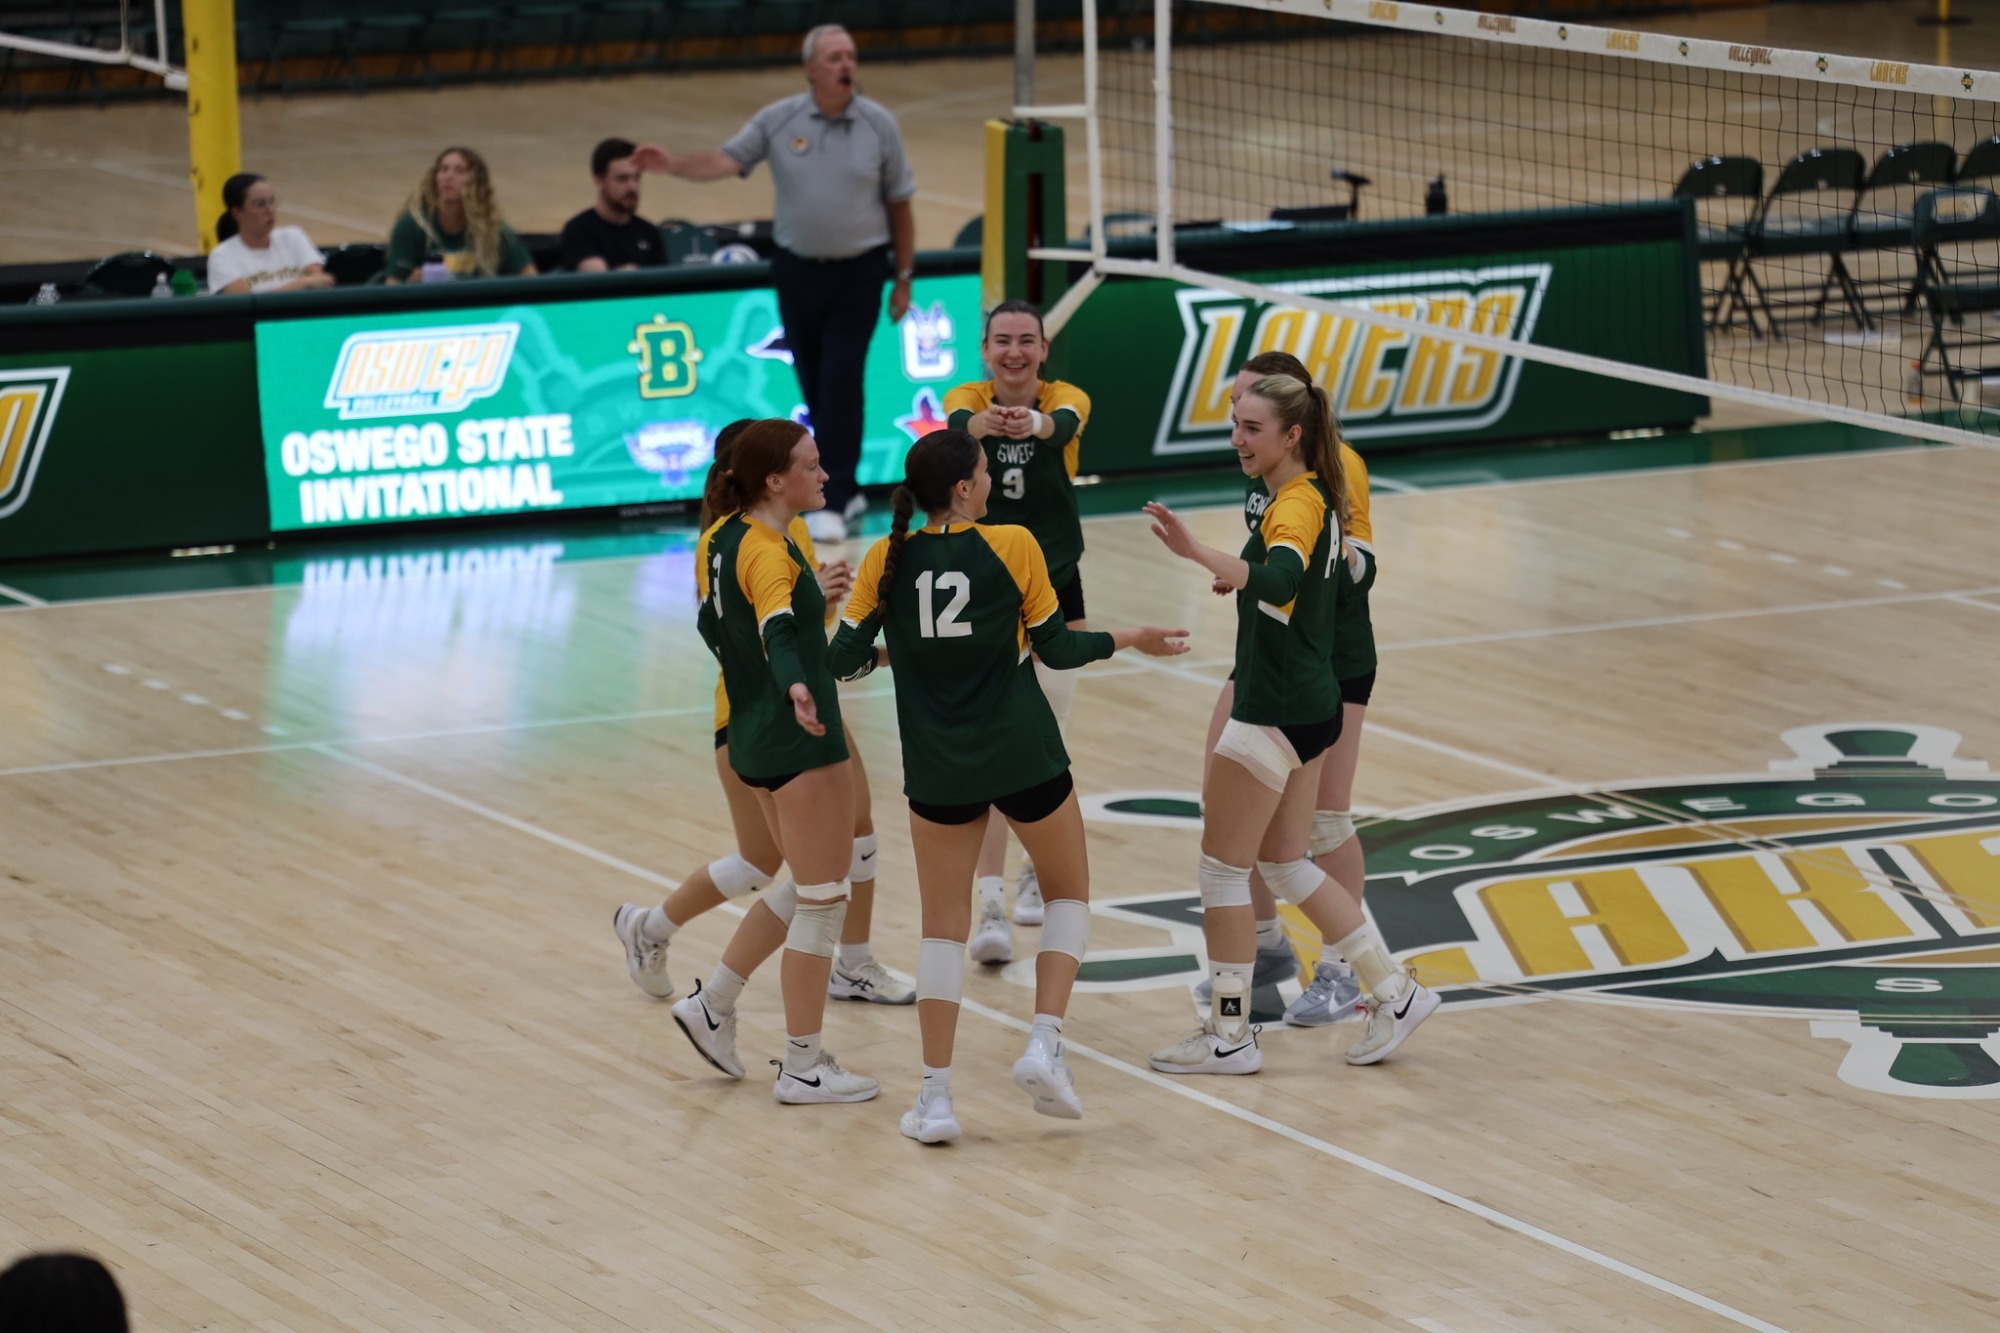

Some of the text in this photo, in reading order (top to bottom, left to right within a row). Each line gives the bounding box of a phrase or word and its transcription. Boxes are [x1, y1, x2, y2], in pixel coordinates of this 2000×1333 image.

[1728, 44, 1772, 67] VOLLEYBALL
[1869, 60, 1910, 85] LAKERS
[336, 332, 509, 401] OSWEGO
[635, 320, 700, 400] B
[280, 422, 449, 477] OSWEGO
[455, 412, 575, 465] STATE
[299, 462, 564, 524] INVITATIONAL
[1002, 467, 1025, 500] 9
[914, 570, 973, 638] 12
[1408, 791, 1999, 862] OSWEGO
